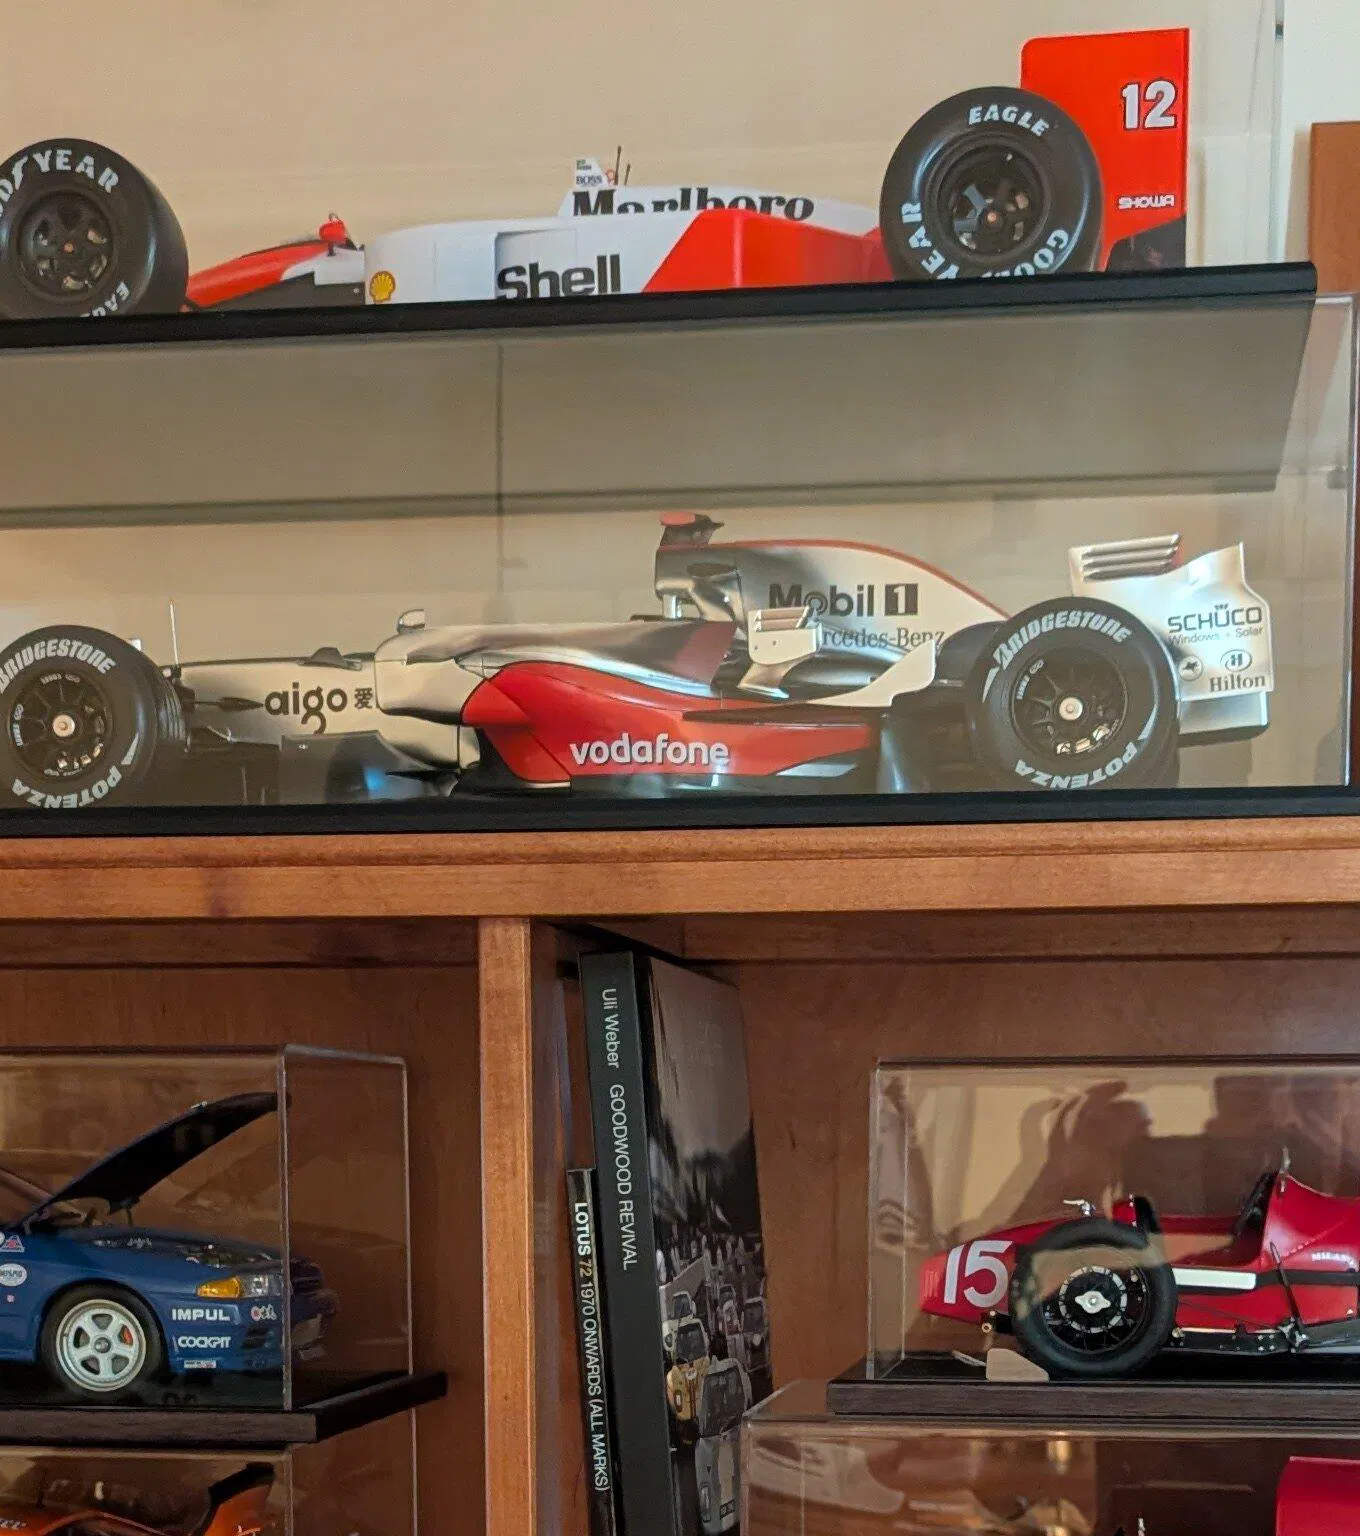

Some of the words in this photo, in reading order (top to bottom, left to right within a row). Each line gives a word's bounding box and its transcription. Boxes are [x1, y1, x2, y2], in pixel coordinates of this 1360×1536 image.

[968, 104, 1049, 137] EAGLE
[1121, 79, 1177, 130] 12
[573, 187, 815, 221] Marlboro
[1118, 194, 1175, 210] SHOWA
[496, 254, 621, 299] Shell
[769, 584, 874, 617] Mobil
[993, 610, 1132, 671] BRIDGESTONE
[1209, 674, 1266, 692] Hilton
[265, 682, 348, 735] aigo
[569, 738, 729, 768] vodafone
[1015, 741, 1138, 789] POTENZA
[11, 764, 122, 809] POTENZA
[602, 988, 618, 1018] Uli
[605, 1020, 620, 1069] Weber
[609, 1082, 633, 1197] GOODWOOD
[574, 1201, 592, 1256] LOTUS
[618, 1199, 638, 1272] REVIVAL
[578, 1257, 593, 1279] 72
[944, 1240, 1012, 1305] 15
[172, 1308, 230, 1320] IMPUL
[580, 1280, 596, 1318] 1970
[582, 1319, 602, 1396] ONWARDS
[587, 1399, 606, 1432] (ALL
[590, 1433, 611, 1492] MARKS)
